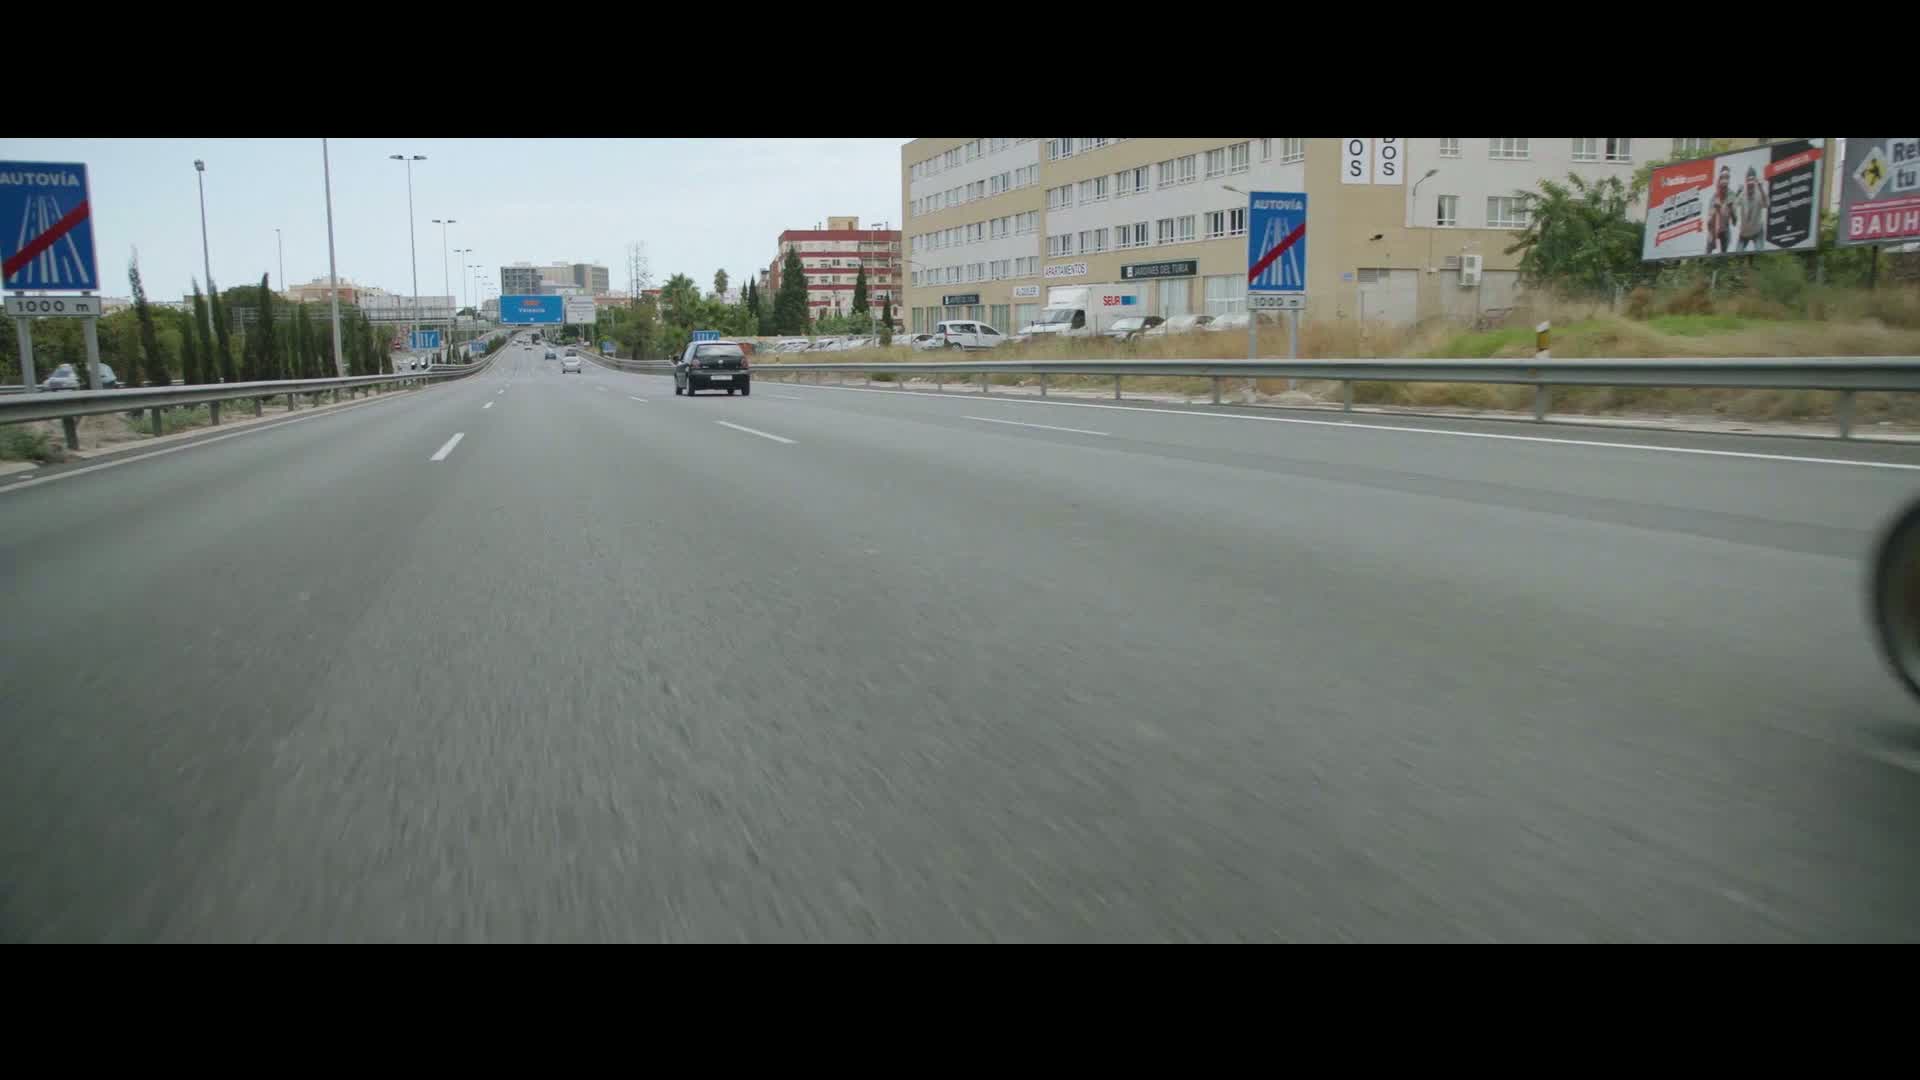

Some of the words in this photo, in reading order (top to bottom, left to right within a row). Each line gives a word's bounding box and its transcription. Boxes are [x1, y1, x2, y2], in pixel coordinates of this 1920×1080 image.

[0, 171, 80, 186] AUTOVÍA
[1253, 198, 1304, 210] AUTOVÍA
[1851, 210, 1920, 236] BAUH
[1045, 263, 1086, 277] APARTAMENTOS
[17, 300, 64, 313] 1000
[76, 303, 89, 313] m
[1103, 295, 1120, 306] SEUR
[1255, 298, 1284, 307] 1000
